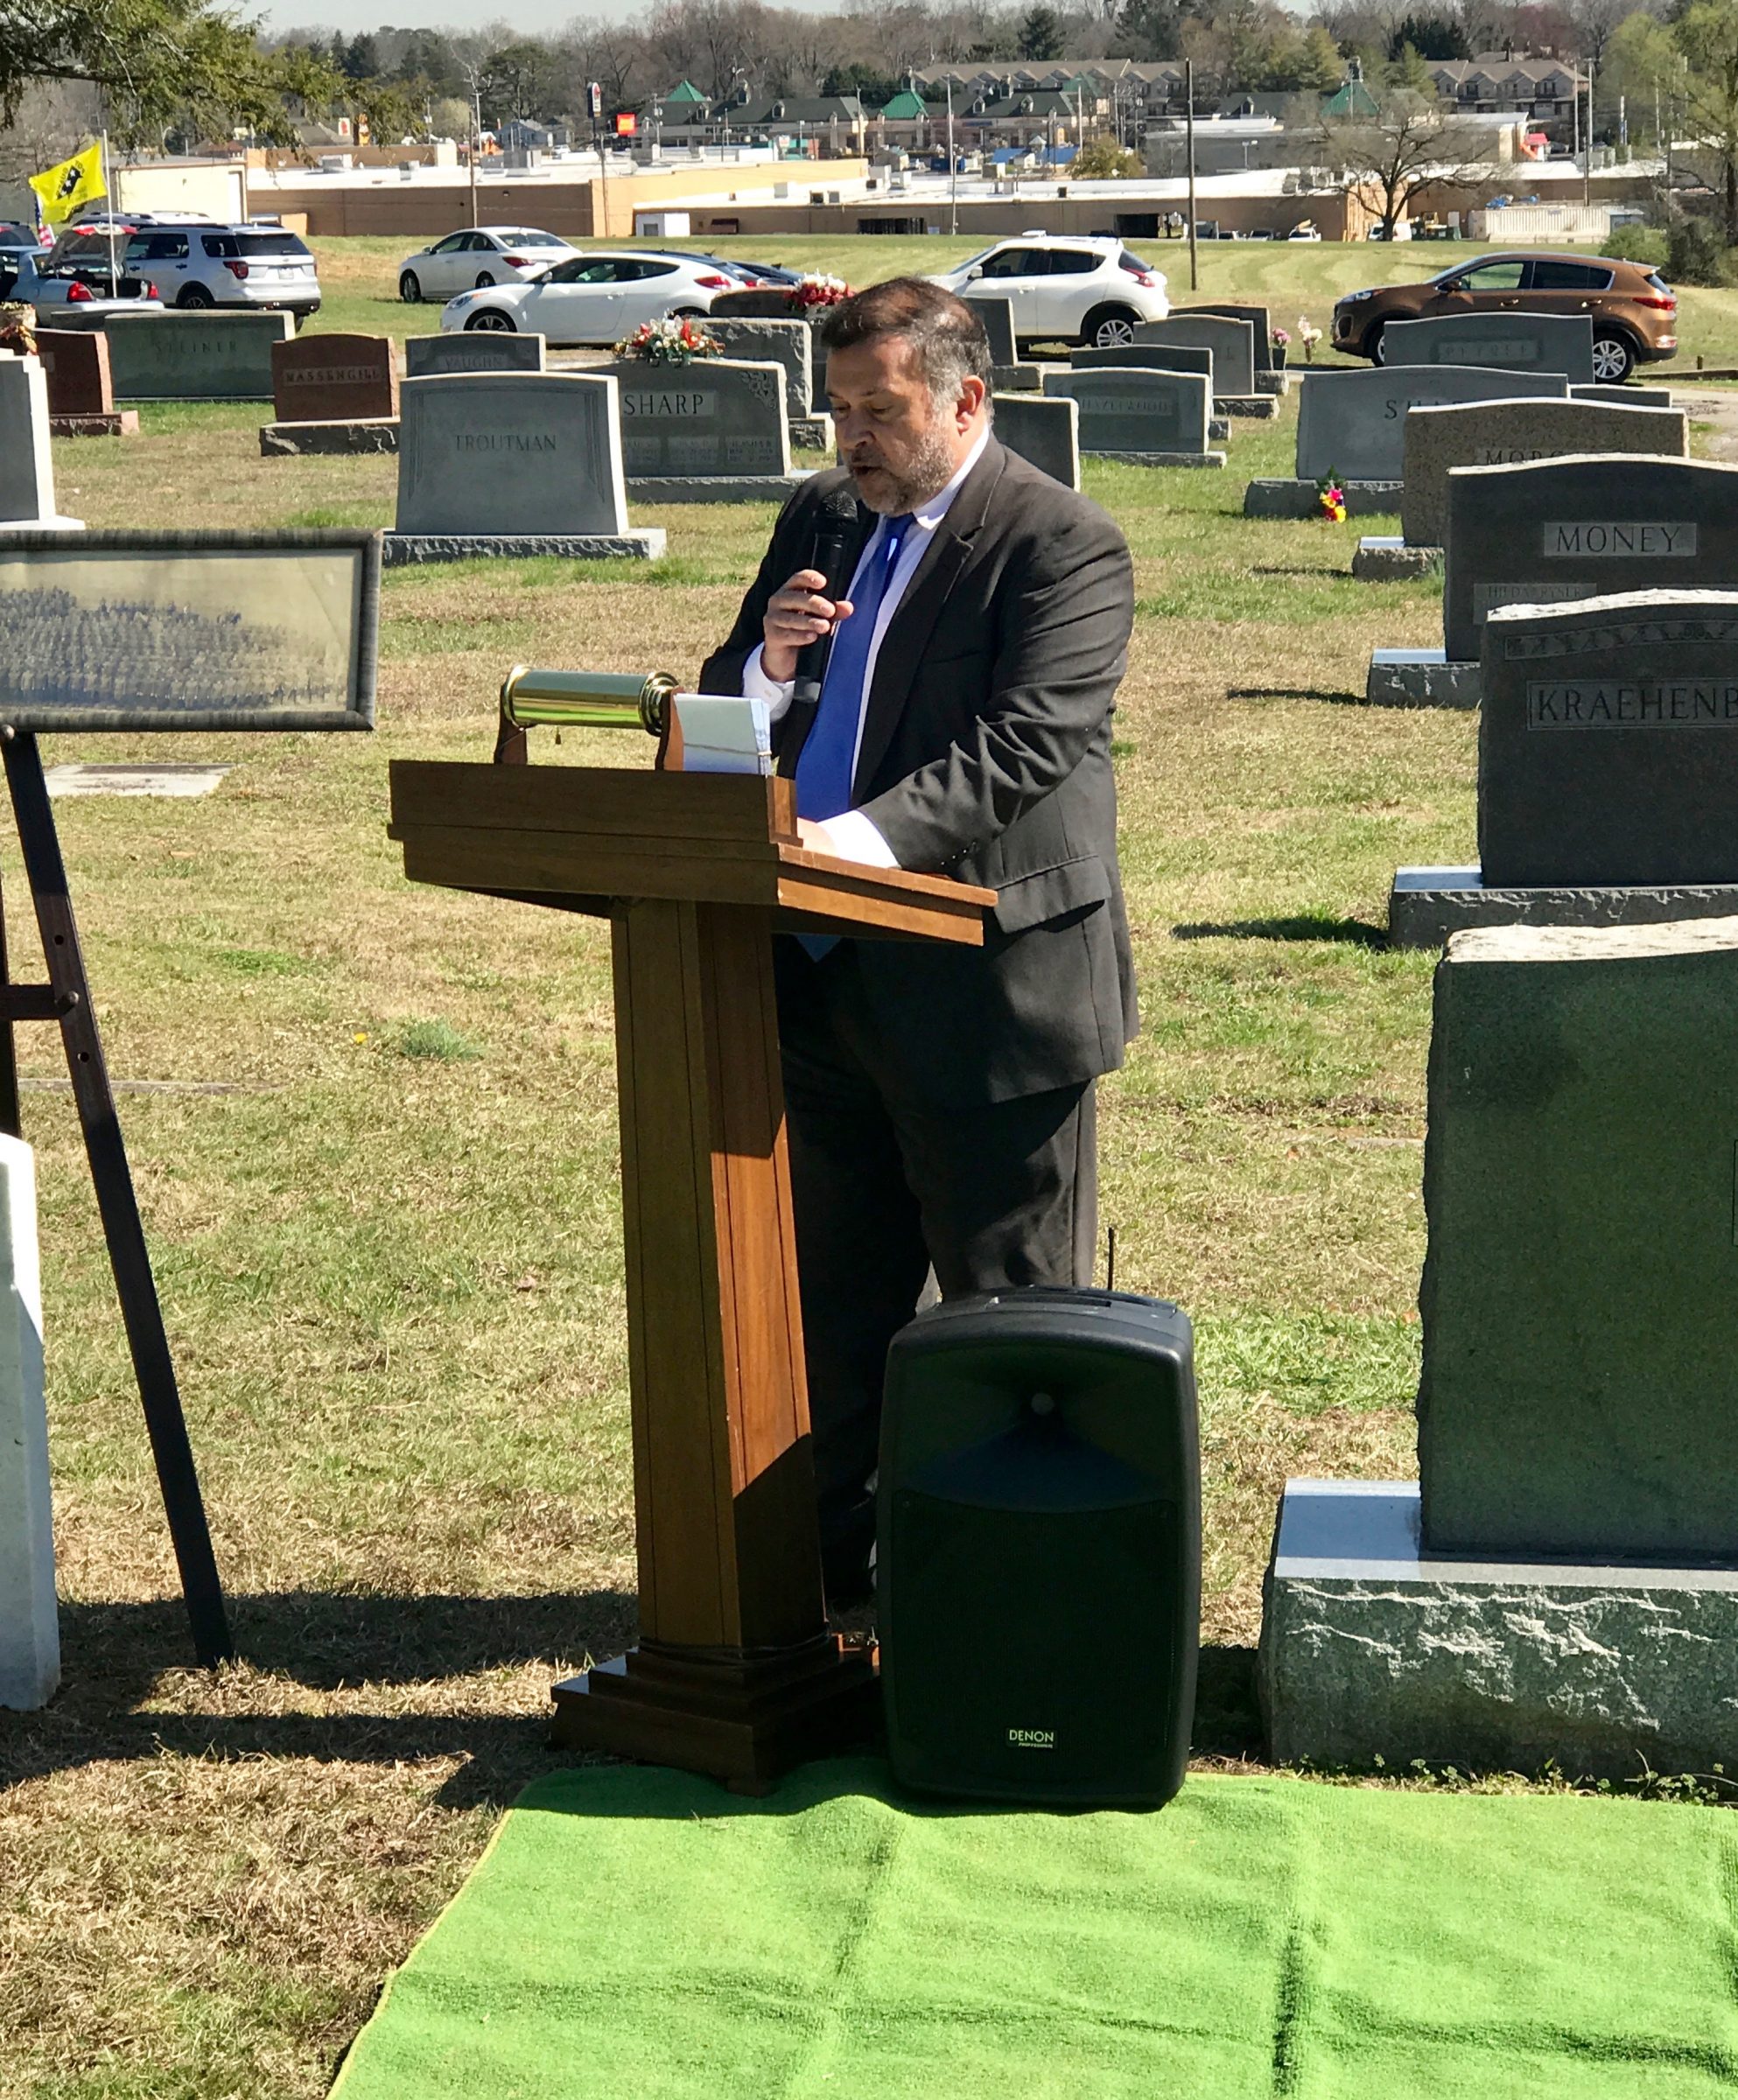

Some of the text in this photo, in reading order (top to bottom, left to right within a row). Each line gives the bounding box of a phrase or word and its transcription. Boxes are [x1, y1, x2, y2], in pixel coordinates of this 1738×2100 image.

[623, 394, 704, 416] SHARP
[455, 434, 557, 452] TROUTMAN
[1556, 526, 1680, 553] MONEY
[1009, 1729, 1054, 1743] DENON
